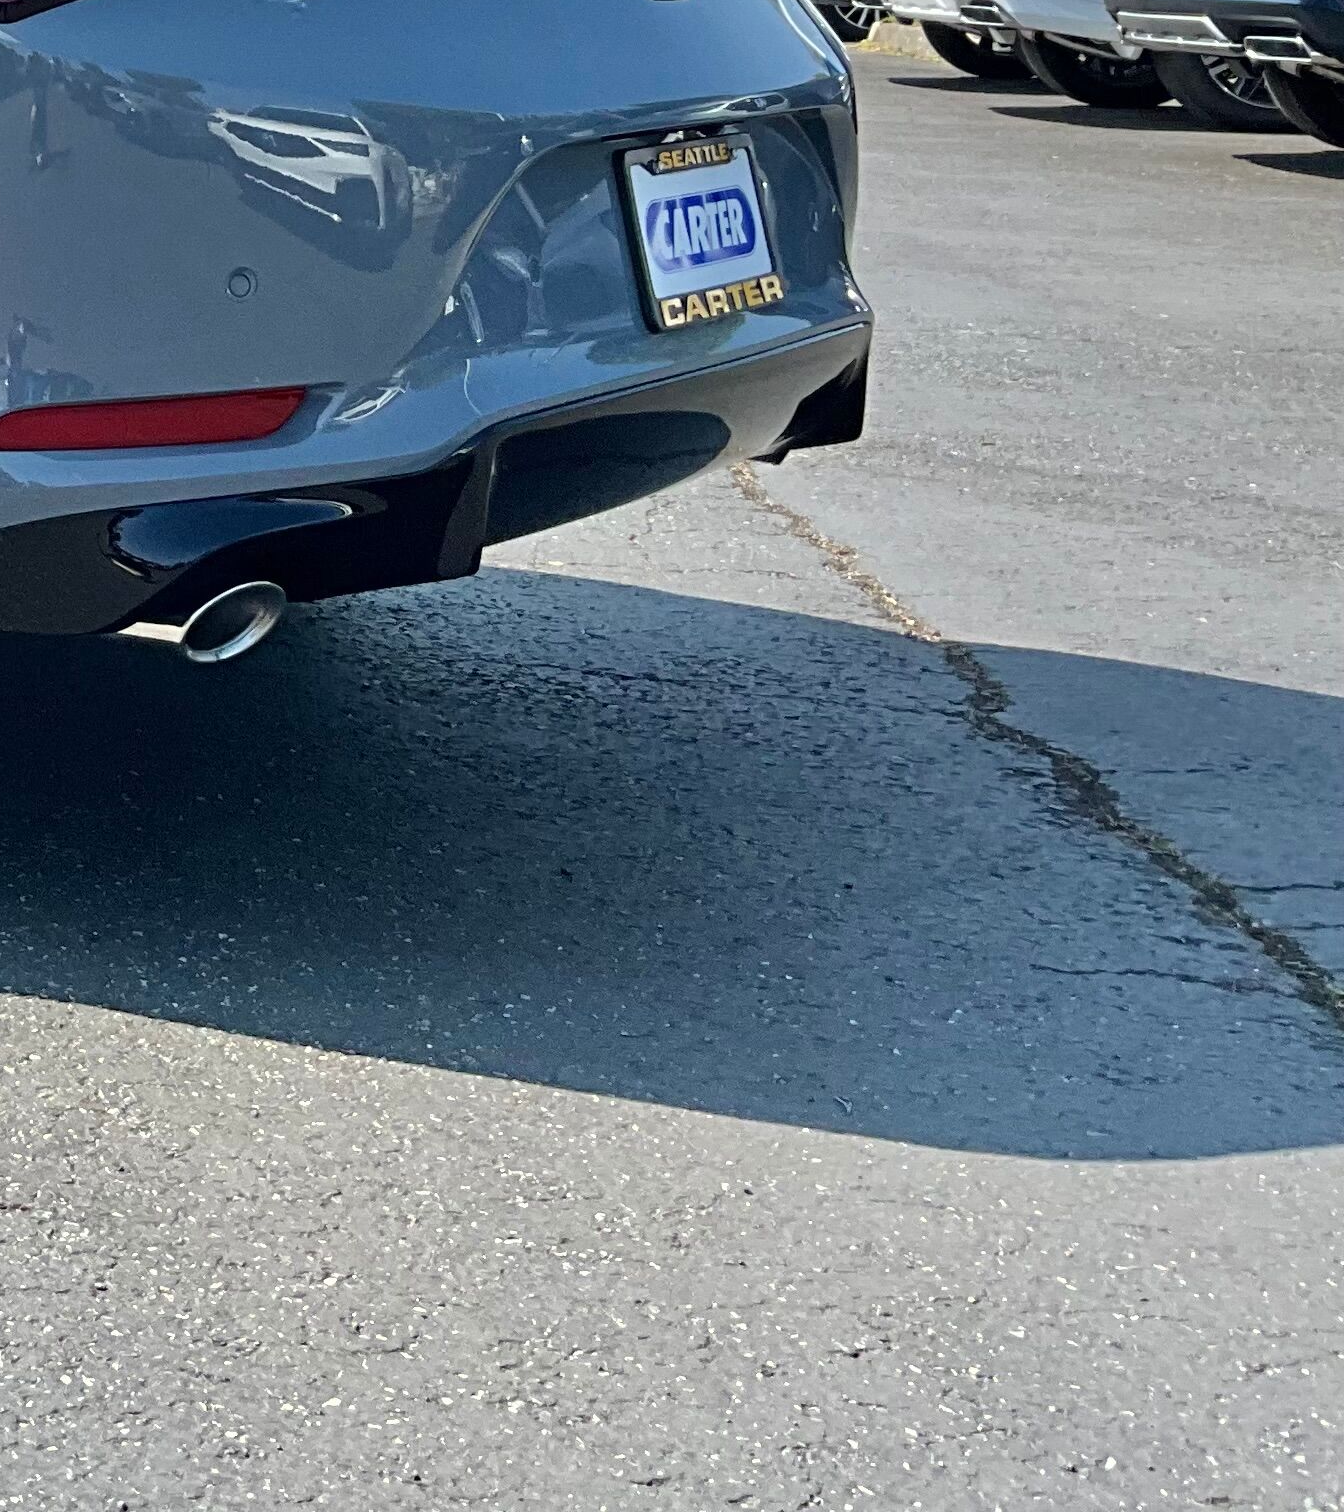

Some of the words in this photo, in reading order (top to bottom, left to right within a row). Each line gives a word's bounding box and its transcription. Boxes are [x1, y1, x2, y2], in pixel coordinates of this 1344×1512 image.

[658, 142, 730, 170] SEATTLE
[652, 198, 748, 261] CARTER
[660, 274, 784, 328] CARTER
